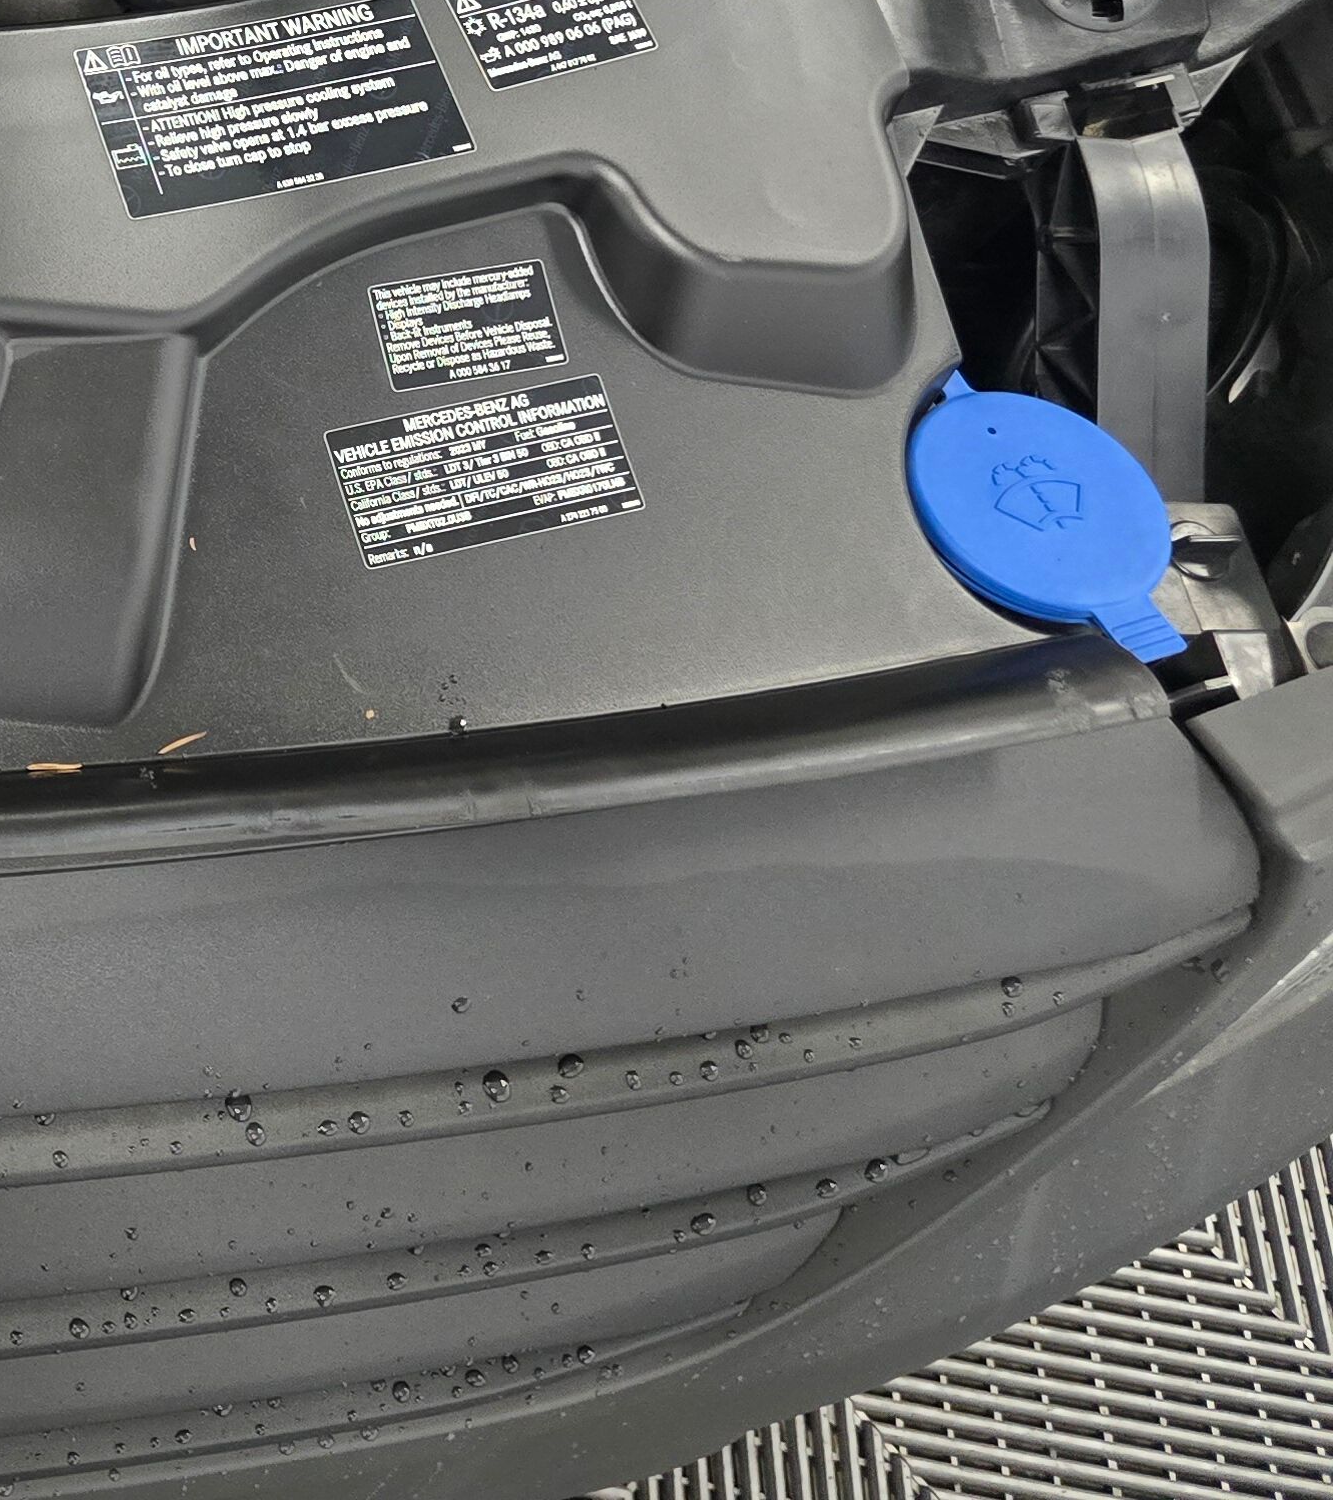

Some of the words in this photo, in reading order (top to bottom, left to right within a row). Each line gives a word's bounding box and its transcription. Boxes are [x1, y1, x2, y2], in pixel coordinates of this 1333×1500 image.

[175, 21, 280, 56] IMPORTANT
[280, 3, 375, 37] WARNING
[131, 70, 153, 84] For
[154, 65, 171, 80] oil
[170, 62, 208, 80] types,
[207, 56, 237, 72] refer
[237, 54, 253, 66] to
[252, 42, 314, 65] Operating
[136, 82, 167, 98] With
[166, 79, 183, 94] oil
[181, 74, 212, 91] level
[212, 70, 249, 86] above
[282, 54, 328, 73] Danger
[329, 48, 344, 63] of
[343, 43, 386, 60] engine
[385, 35, 411, 52] and
[190, 87, 239, 105] damage
[220, 103, 252, 121] High
[250, 95, 305, 118] pressure
[305, 85, 352, 104] cooling
[350, 76, 396, 97] system
[154, 130, 199, 148] Relieve
[198, 123, 227, 141] high
[226, 115, 280, 138] pressure
[280, 106, 319, 125] slowly
[159, 145, 199, 162] Safety
[198, 140, 232, 156] valve
[232, 133, 271, 151] opens
[270, 128, 287, 142] at
[286, 123, 308, 139] 1.4
[306, 120, 330, 135] bar
[331, 112, 375, 130] excess
[373, 101, 429, 124] pressure
[163, 163, 183, 177] To
[183, 159, 216, 174] close
[215, 154, 244, 168] turn
[243, 149, 268, 164] cap
[266, 146, 283, 159] to
[282, 141, 312, 156] stop
[333, 439, 391, 464] VEHICLE
[389, 425, 455, 452] EMISSION
[455, 413, 518, 438] CONTROL
[516, 393, 606, 425] INFORMATION
[402, 397, 510, 433] MERCEDES-BENZ
[510, 393, 530, 410] AG
